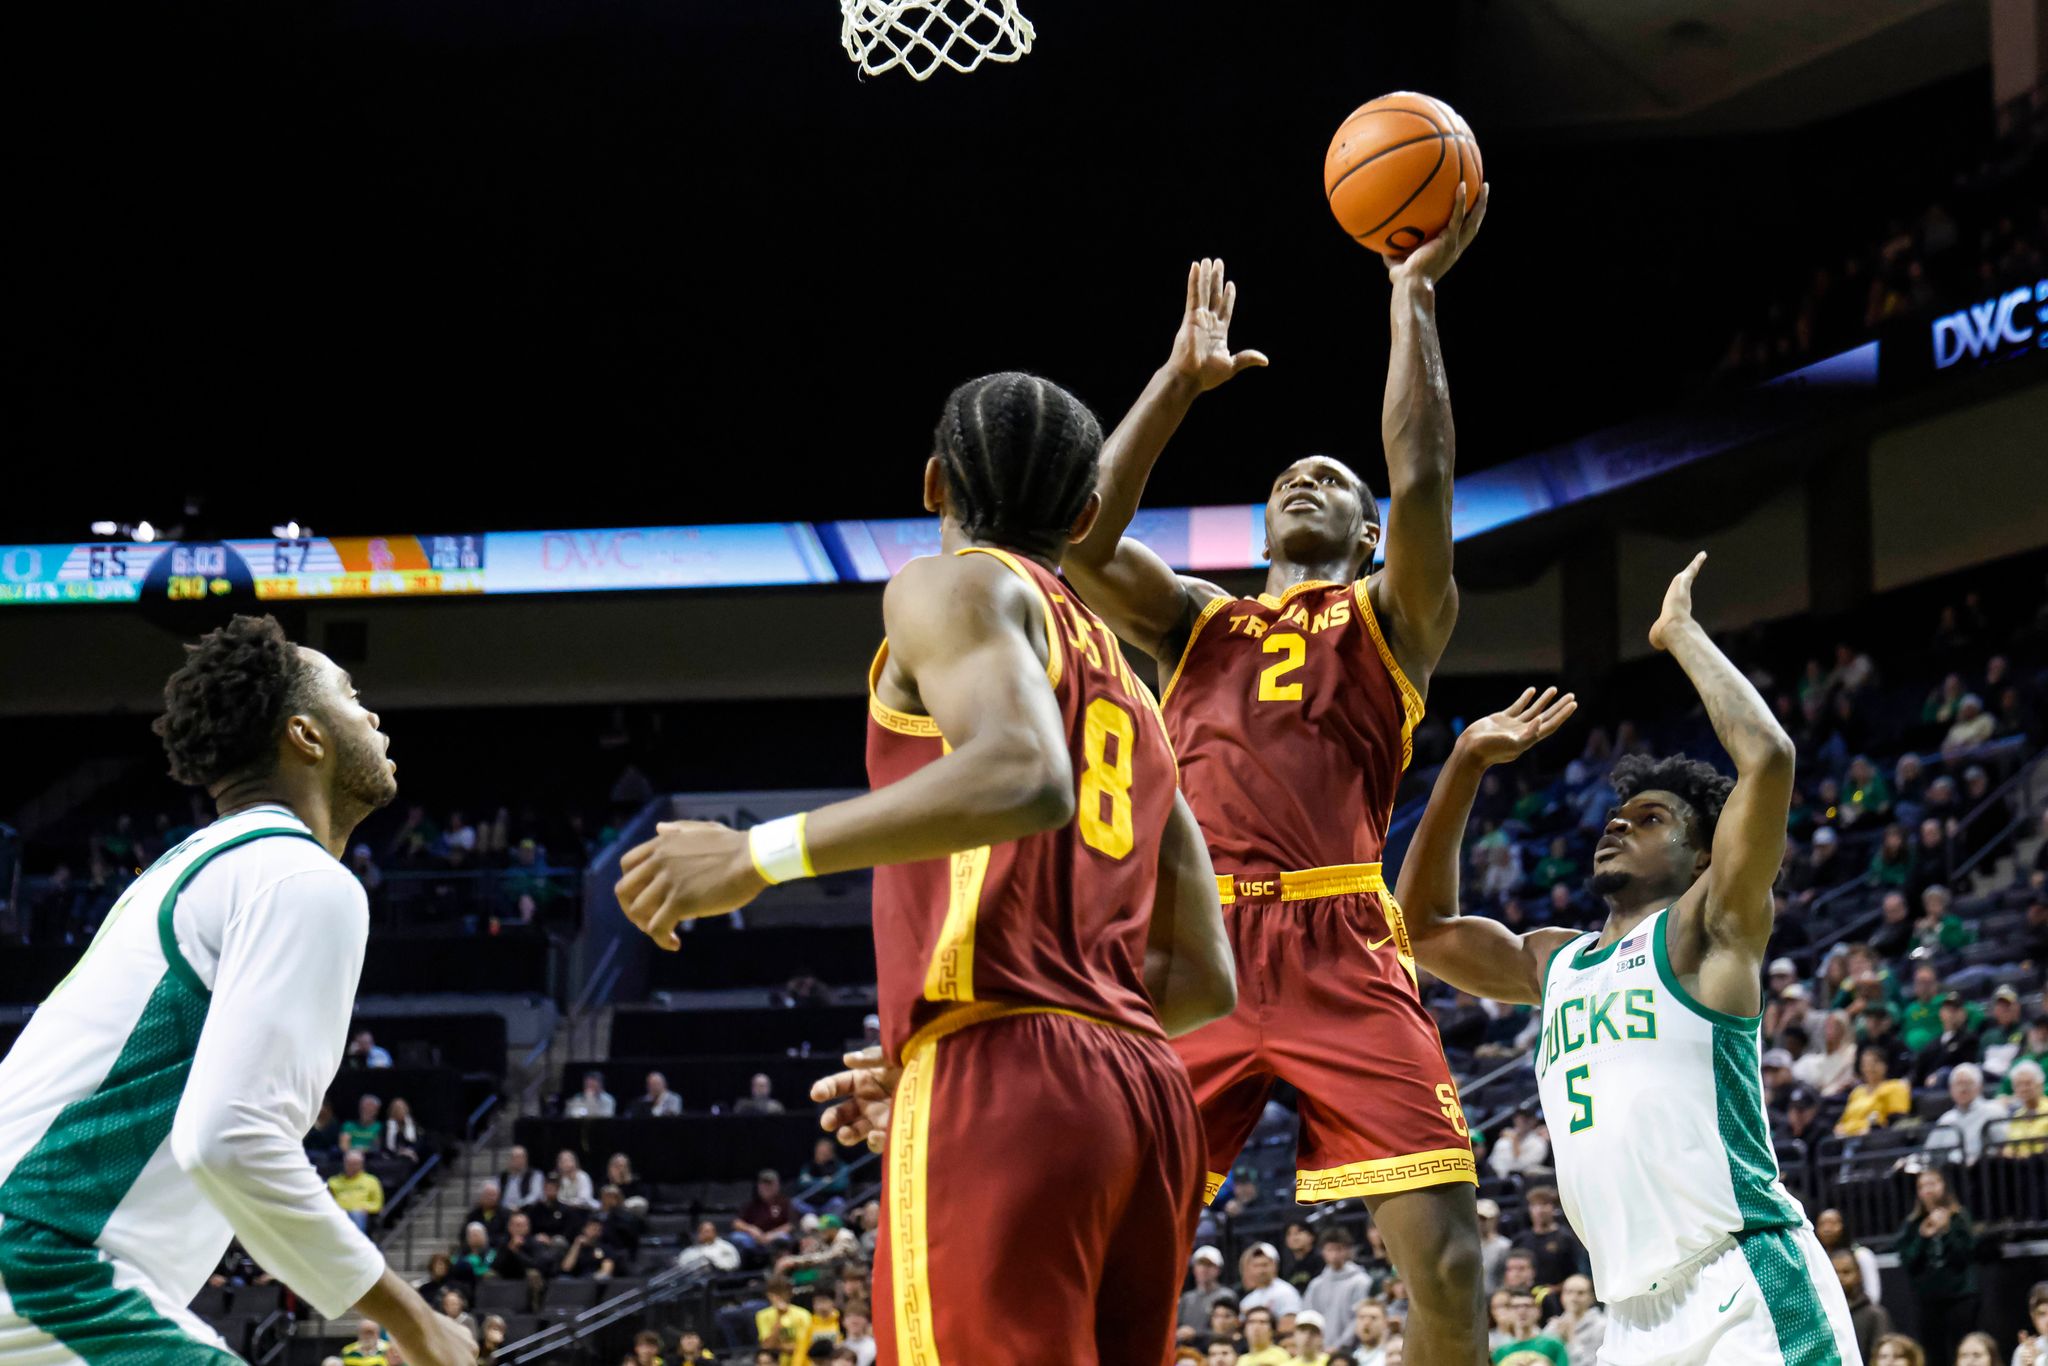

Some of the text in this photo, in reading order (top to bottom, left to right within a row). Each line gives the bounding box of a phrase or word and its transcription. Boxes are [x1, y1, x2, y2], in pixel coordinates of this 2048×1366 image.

[1931, 286, 2033, 369] DWC
[274, 539, 310, 575] 67
[1229, 600, 1349, 638] TRJANS
[1258, 633, 1306, 701] 2
[1079, 697, 1135, 860] 8
[1240, 881, 1274, 896] USC
[1565, 1064, 1594, 1134] 5
